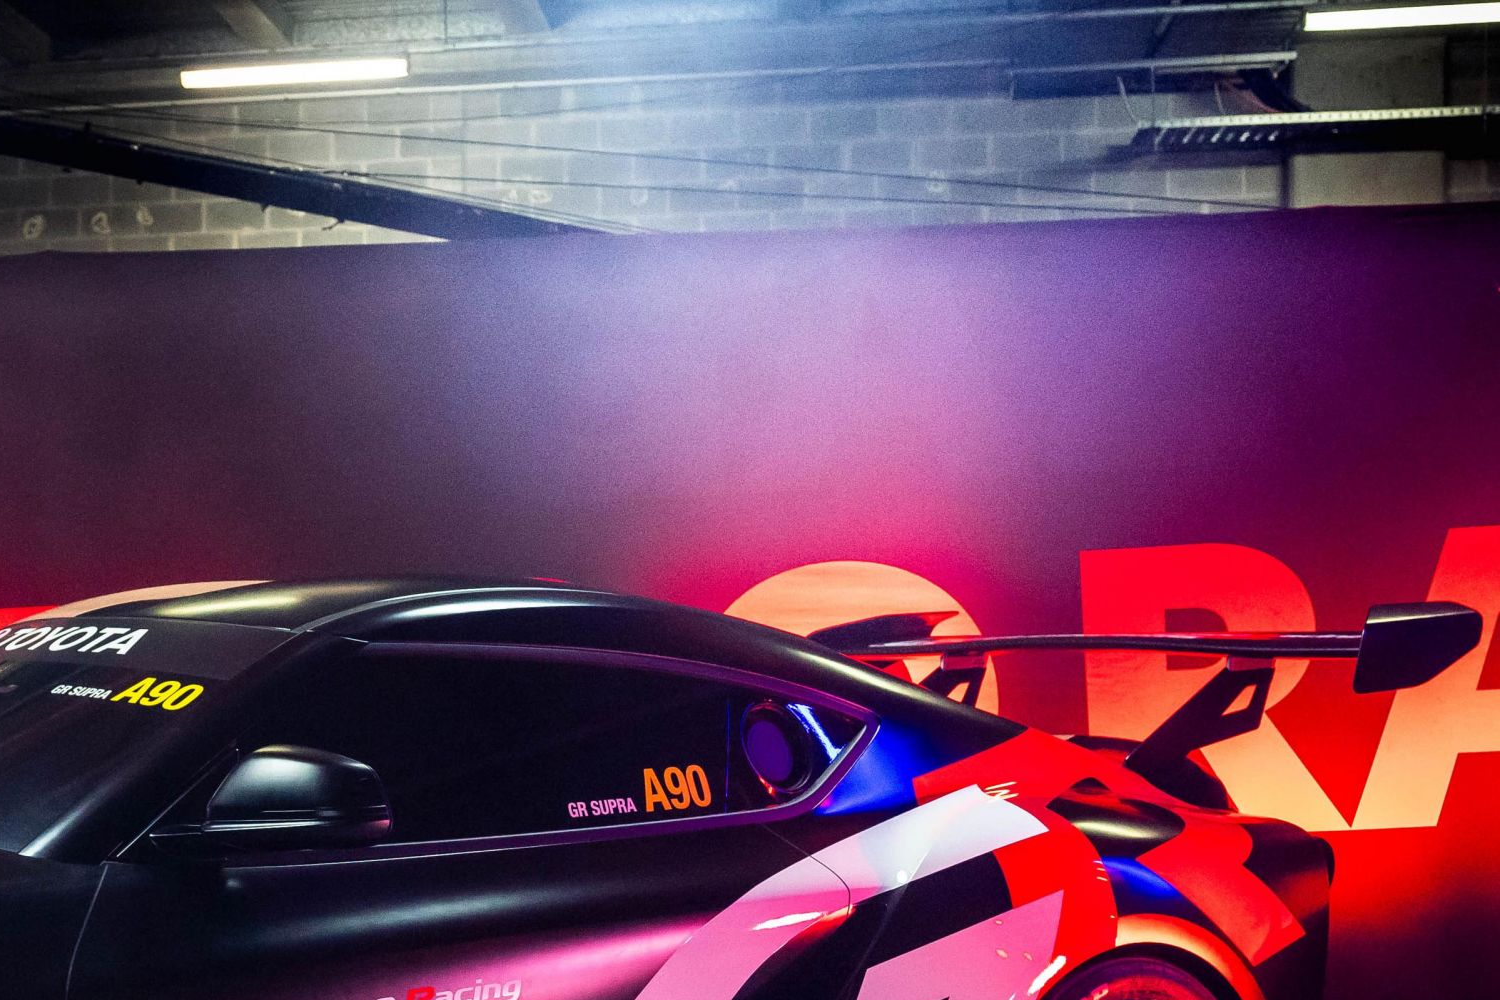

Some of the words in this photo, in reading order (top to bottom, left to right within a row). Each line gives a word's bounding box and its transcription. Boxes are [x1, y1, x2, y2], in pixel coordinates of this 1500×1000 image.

[50, 684, 71, 696] GR
[69, 686, 113, 700] SUPRA
[110, 677, 205, 711] A90
[567, 801, 589, 818] GR
[590, 797, 638, 817] SUPRA
[643, 764, 712, 813] A90
